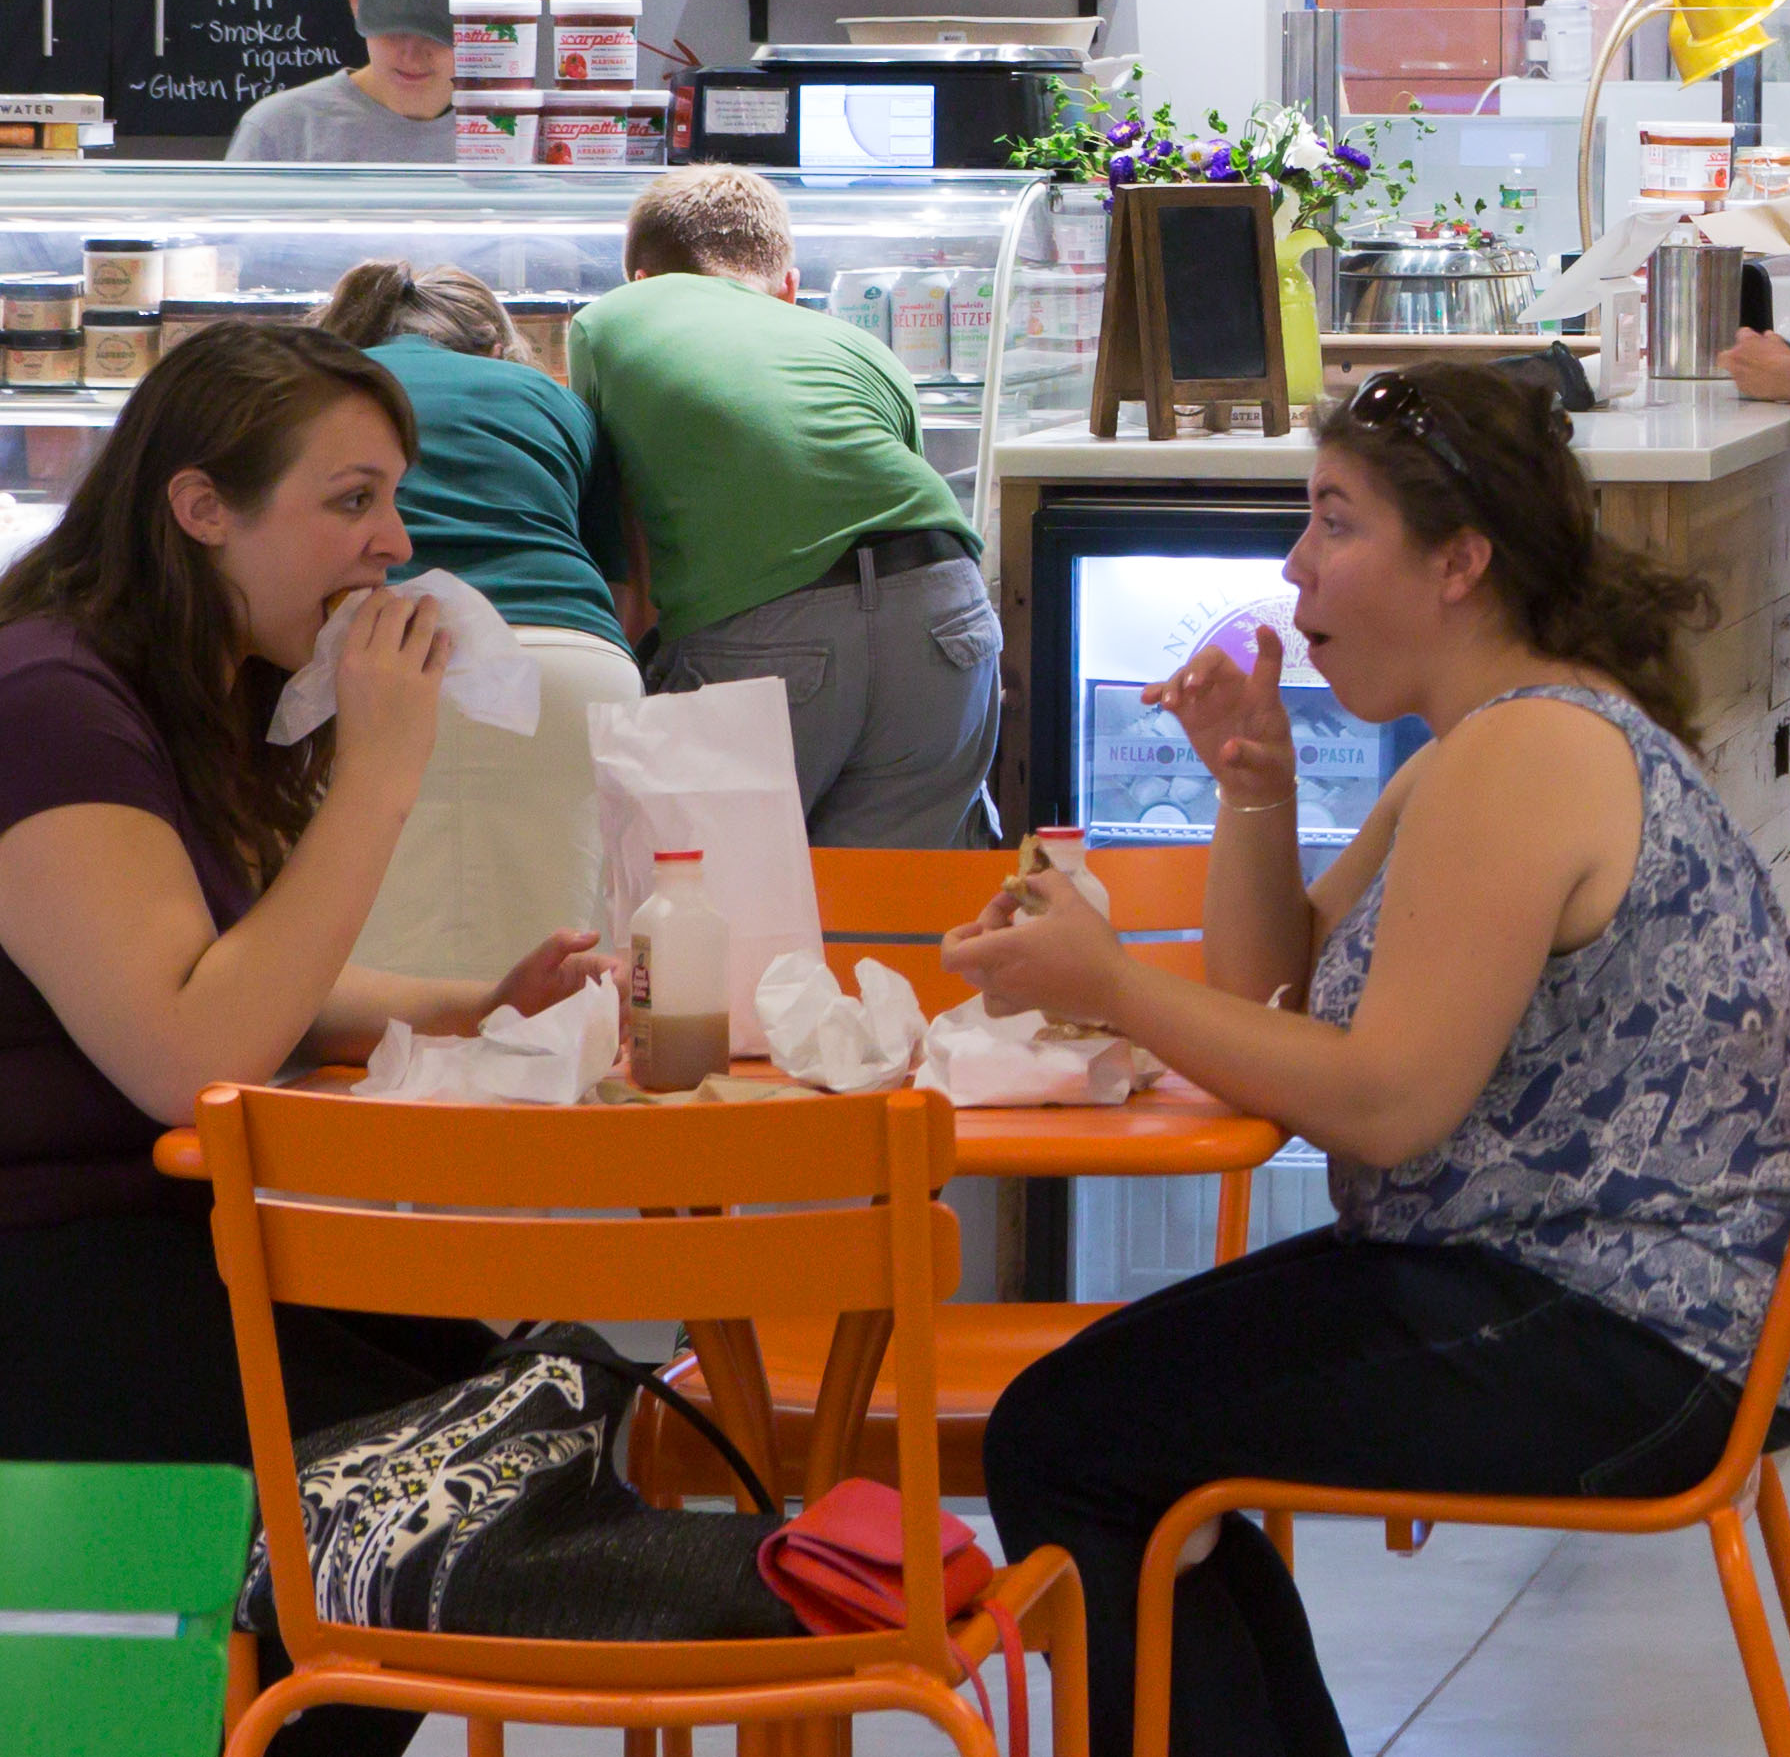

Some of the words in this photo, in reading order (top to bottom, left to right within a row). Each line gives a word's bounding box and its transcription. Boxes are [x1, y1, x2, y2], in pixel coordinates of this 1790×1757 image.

[208, 15, 306, 44] Smoked
[149, 74, 226, 102] Gluten
[0, 105, 54, 115] WATER
[894, 313, 945, 328] SELTZER
[952, 312, 992, 327] ELTZER
[1109, 746, 1155, 772] NELLA
[1318, 746, 1365, 774] PASTA
